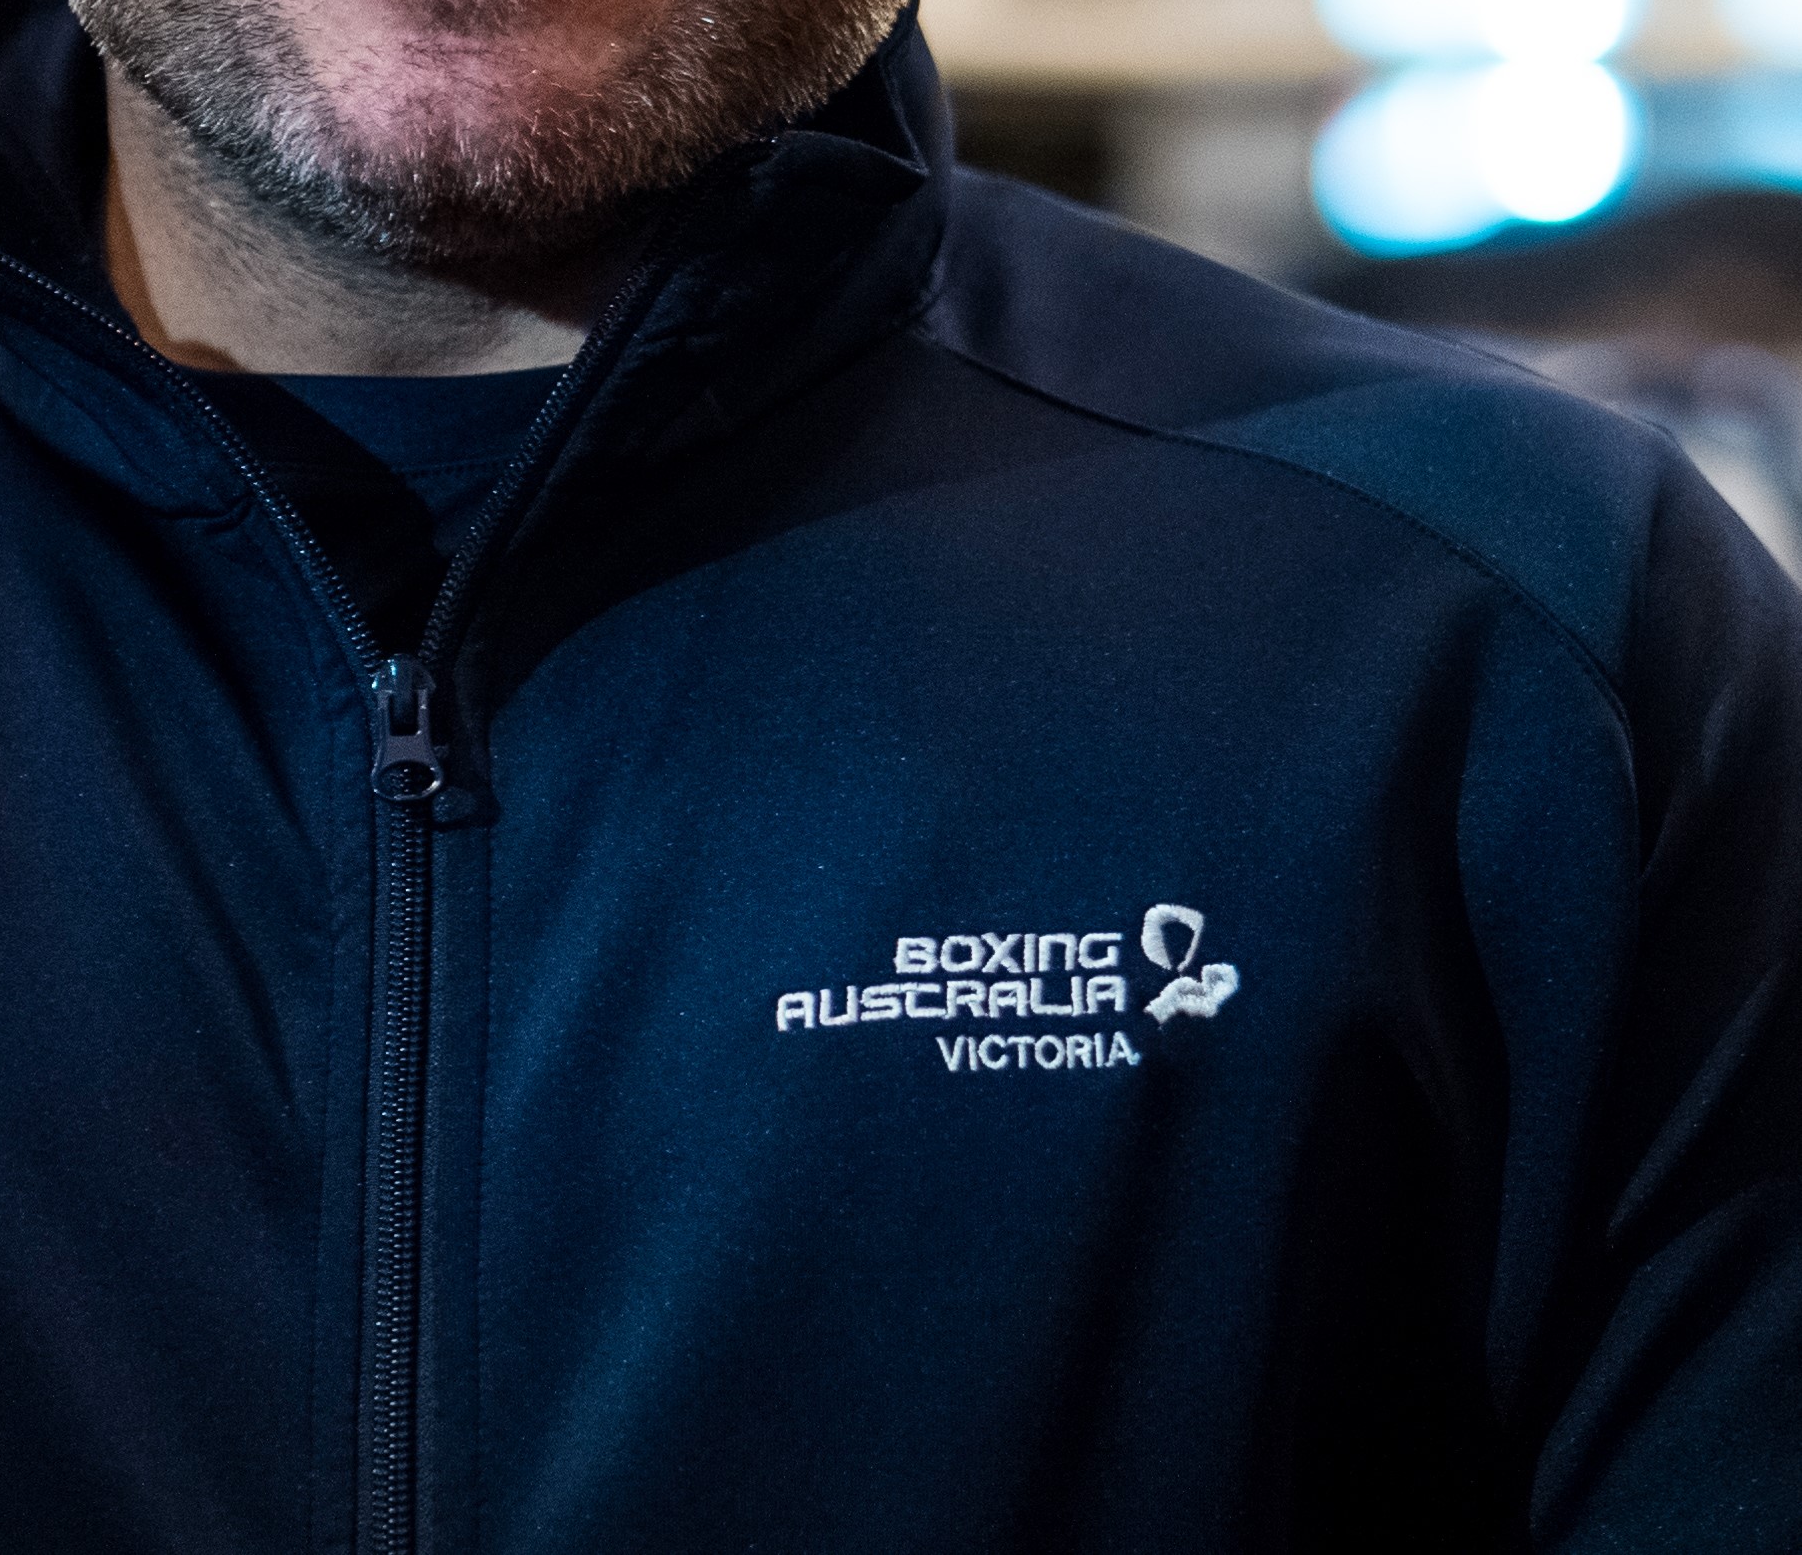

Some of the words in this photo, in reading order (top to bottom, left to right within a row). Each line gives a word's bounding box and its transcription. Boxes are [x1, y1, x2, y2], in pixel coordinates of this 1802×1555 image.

[894, 931, 1124, 974] BOXING
[776, 975, 1126, 1031] AUSTRALIA
[935, 1032, 1140, 1072] VICTORIA
